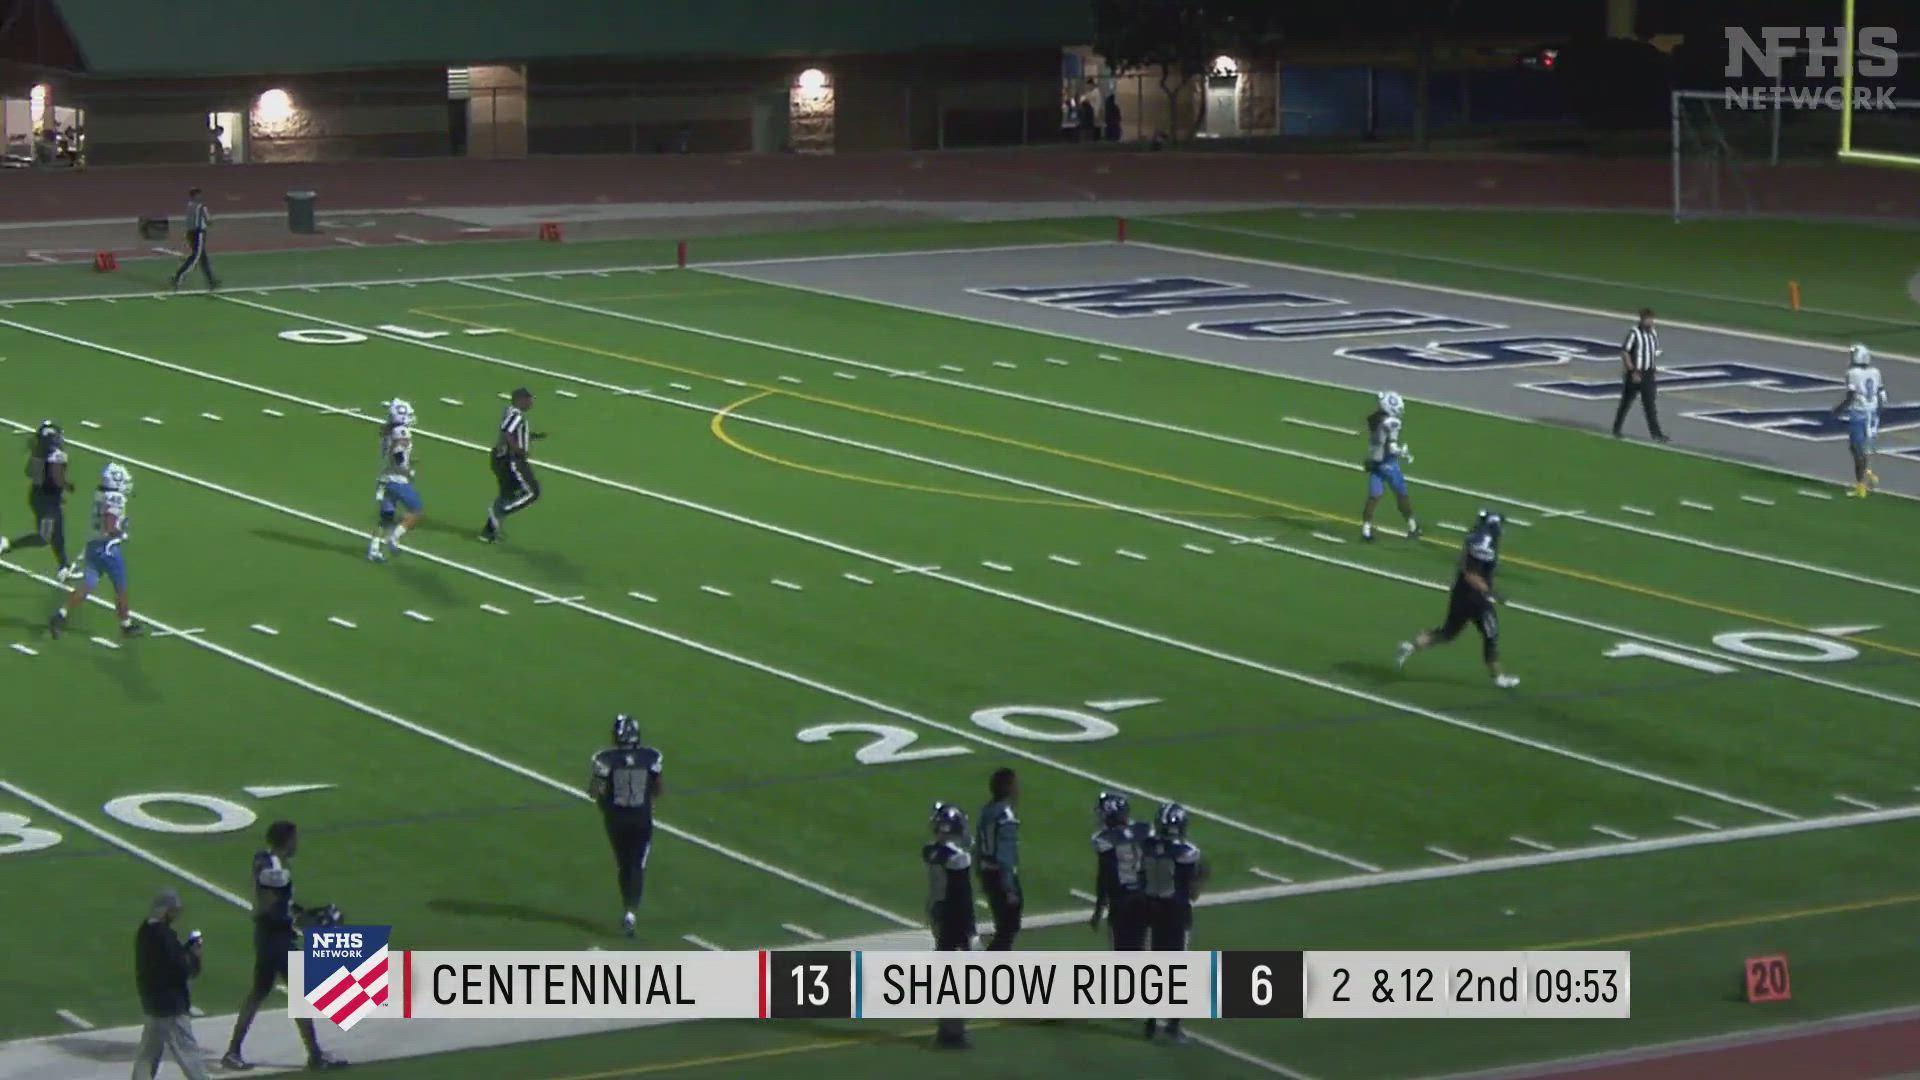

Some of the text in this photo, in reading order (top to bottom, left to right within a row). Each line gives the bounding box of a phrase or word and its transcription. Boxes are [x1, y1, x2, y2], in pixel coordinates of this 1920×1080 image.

[1602, 632, 1859, 674] 10
[797, 706, 1119, 764] 20
[1752, 960, 1786, 997] 20
